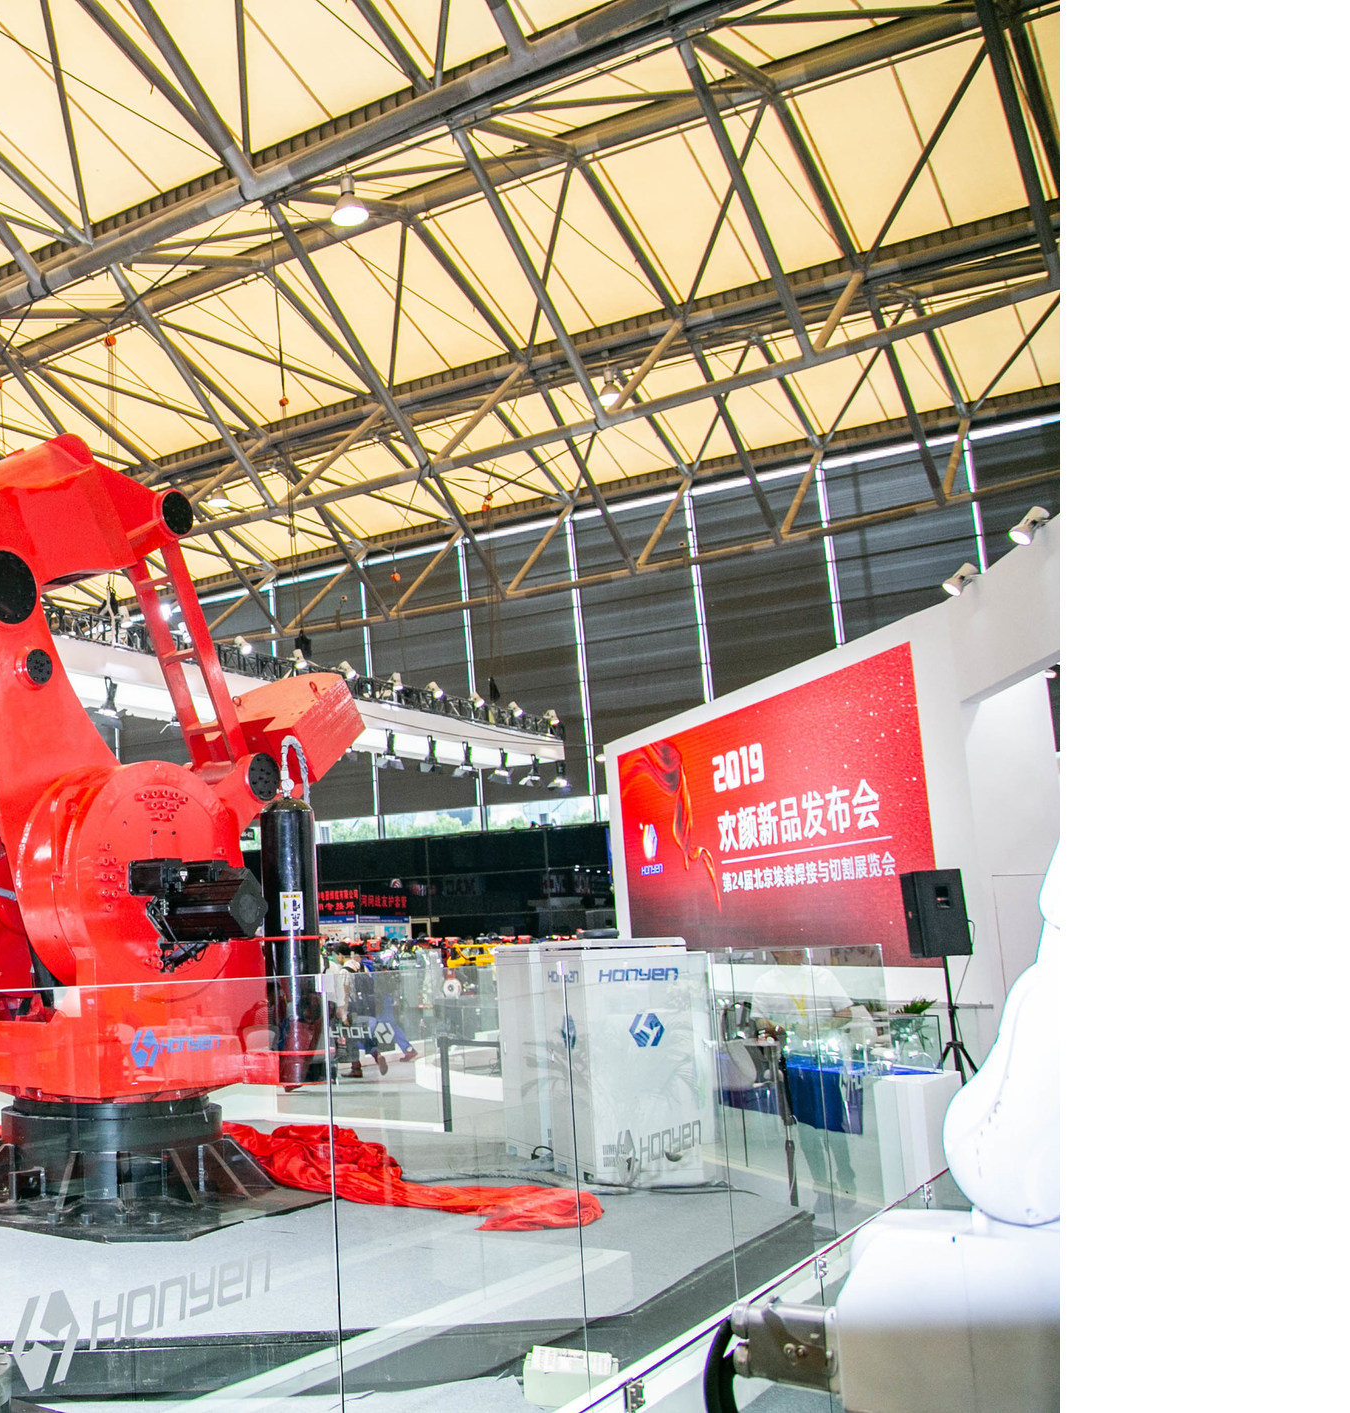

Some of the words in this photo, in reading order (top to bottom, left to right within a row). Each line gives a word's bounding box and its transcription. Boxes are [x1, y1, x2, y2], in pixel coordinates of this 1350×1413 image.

[712, 742, 764, 793] 2019
[717, 778, 880, 853] 欢颜新品发布会
[721, 850, 896, 893] 第24届北京埃森焊接与切割展览会
